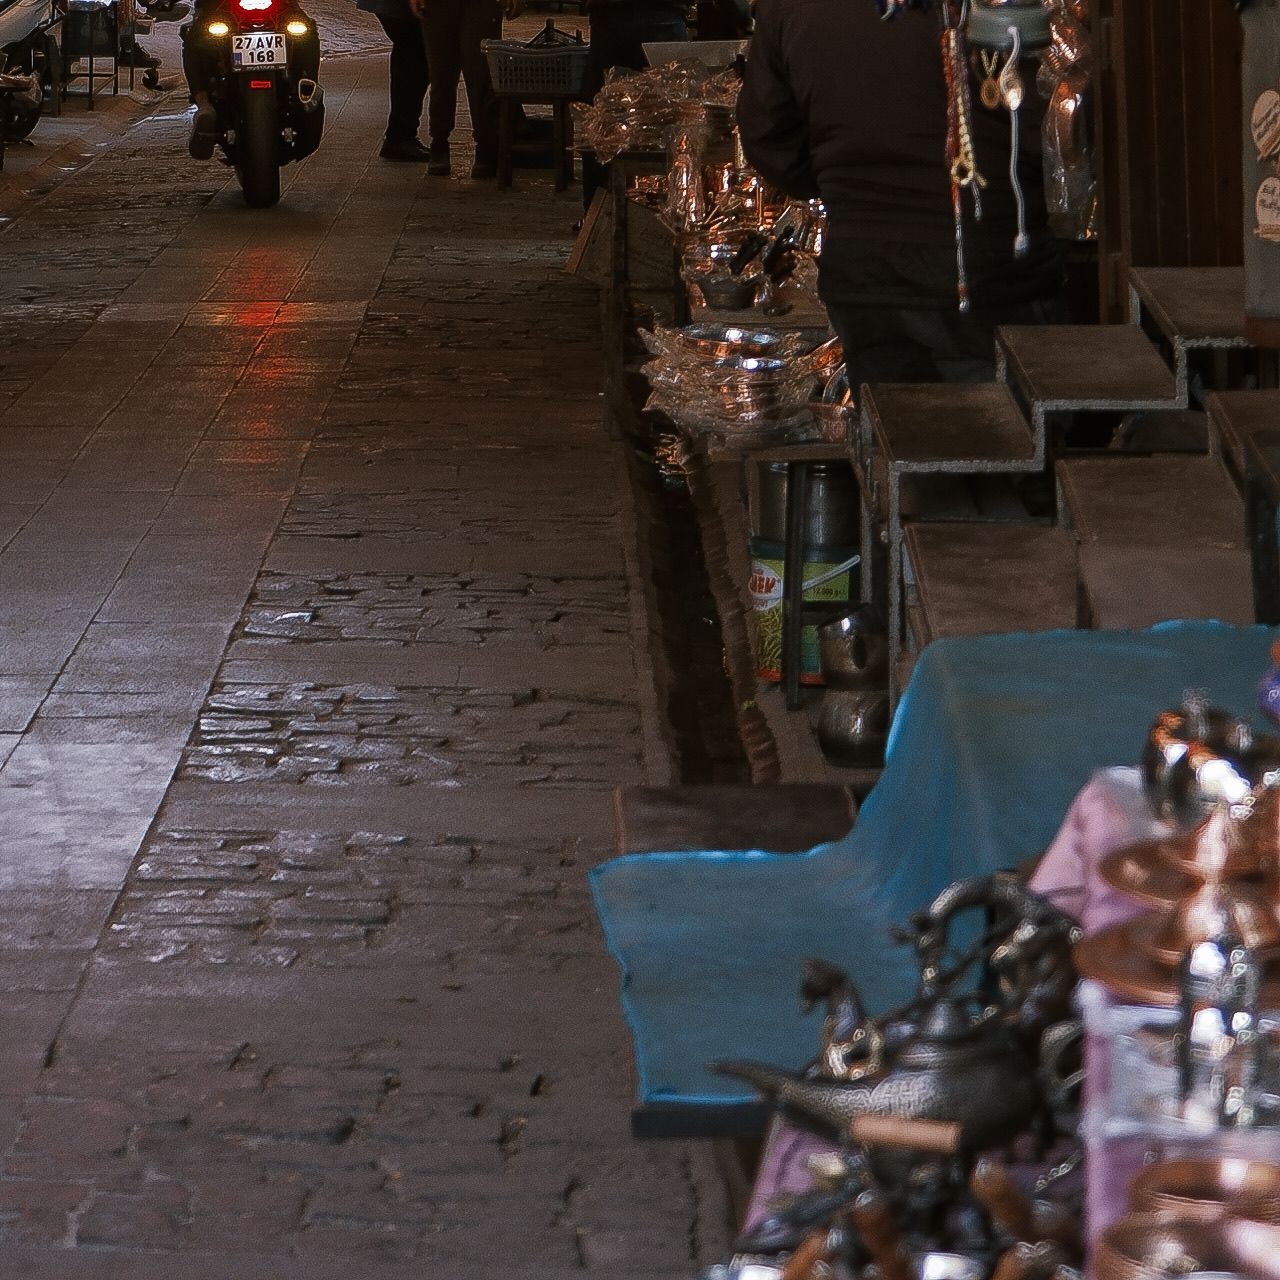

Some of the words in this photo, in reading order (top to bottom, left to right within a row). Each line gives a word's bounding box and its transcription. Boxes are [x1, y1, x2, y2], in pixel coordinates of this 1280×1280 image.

[235, 37, 252, 49] 27
[256, 36, 283, 49] AVR
[249, 50, 274, 63] 168
